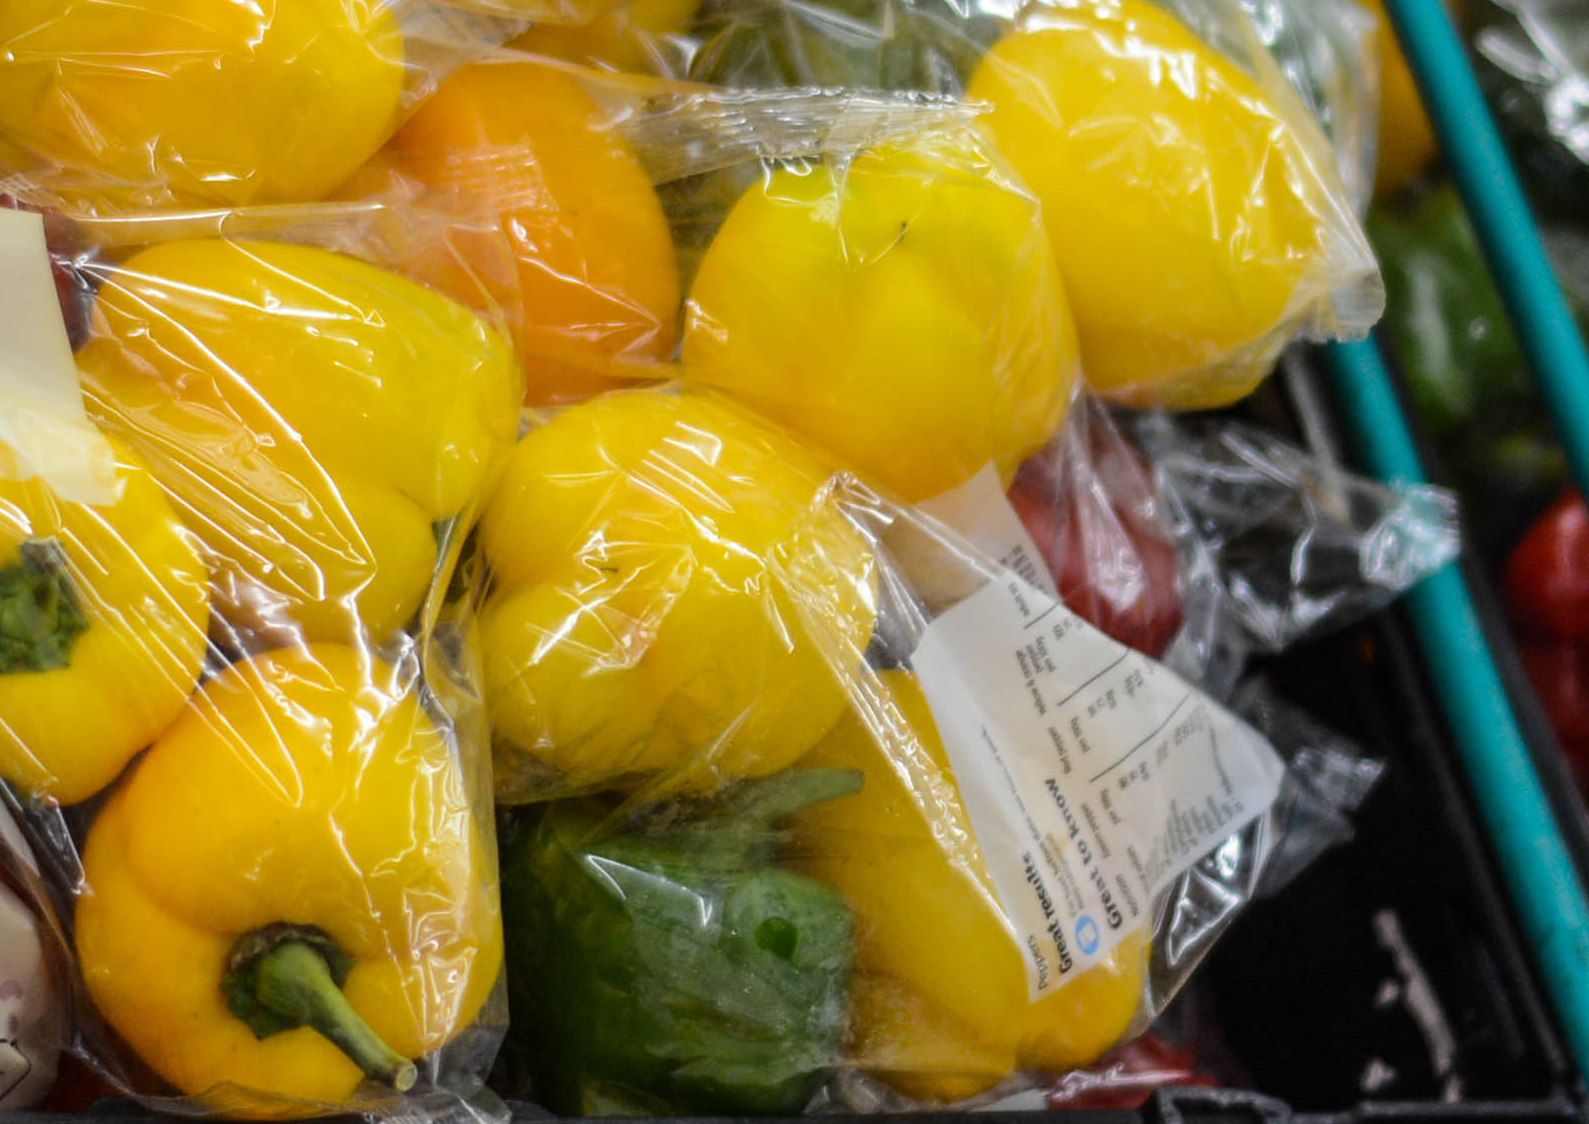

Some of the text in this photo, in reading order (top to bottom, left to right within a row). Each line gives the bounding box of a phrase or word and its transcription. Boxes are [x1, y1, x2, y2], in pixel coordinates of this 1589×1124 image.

[1044, 777, 1080, 840] know
[1076, 839, 1093, 866] to
[1022, 849, 1056, 919] results
[1090, 866, 1124, 931] Great
[1026, 934, 1049, 991] Peppers
[1046, 918, 1074, 975] Great
